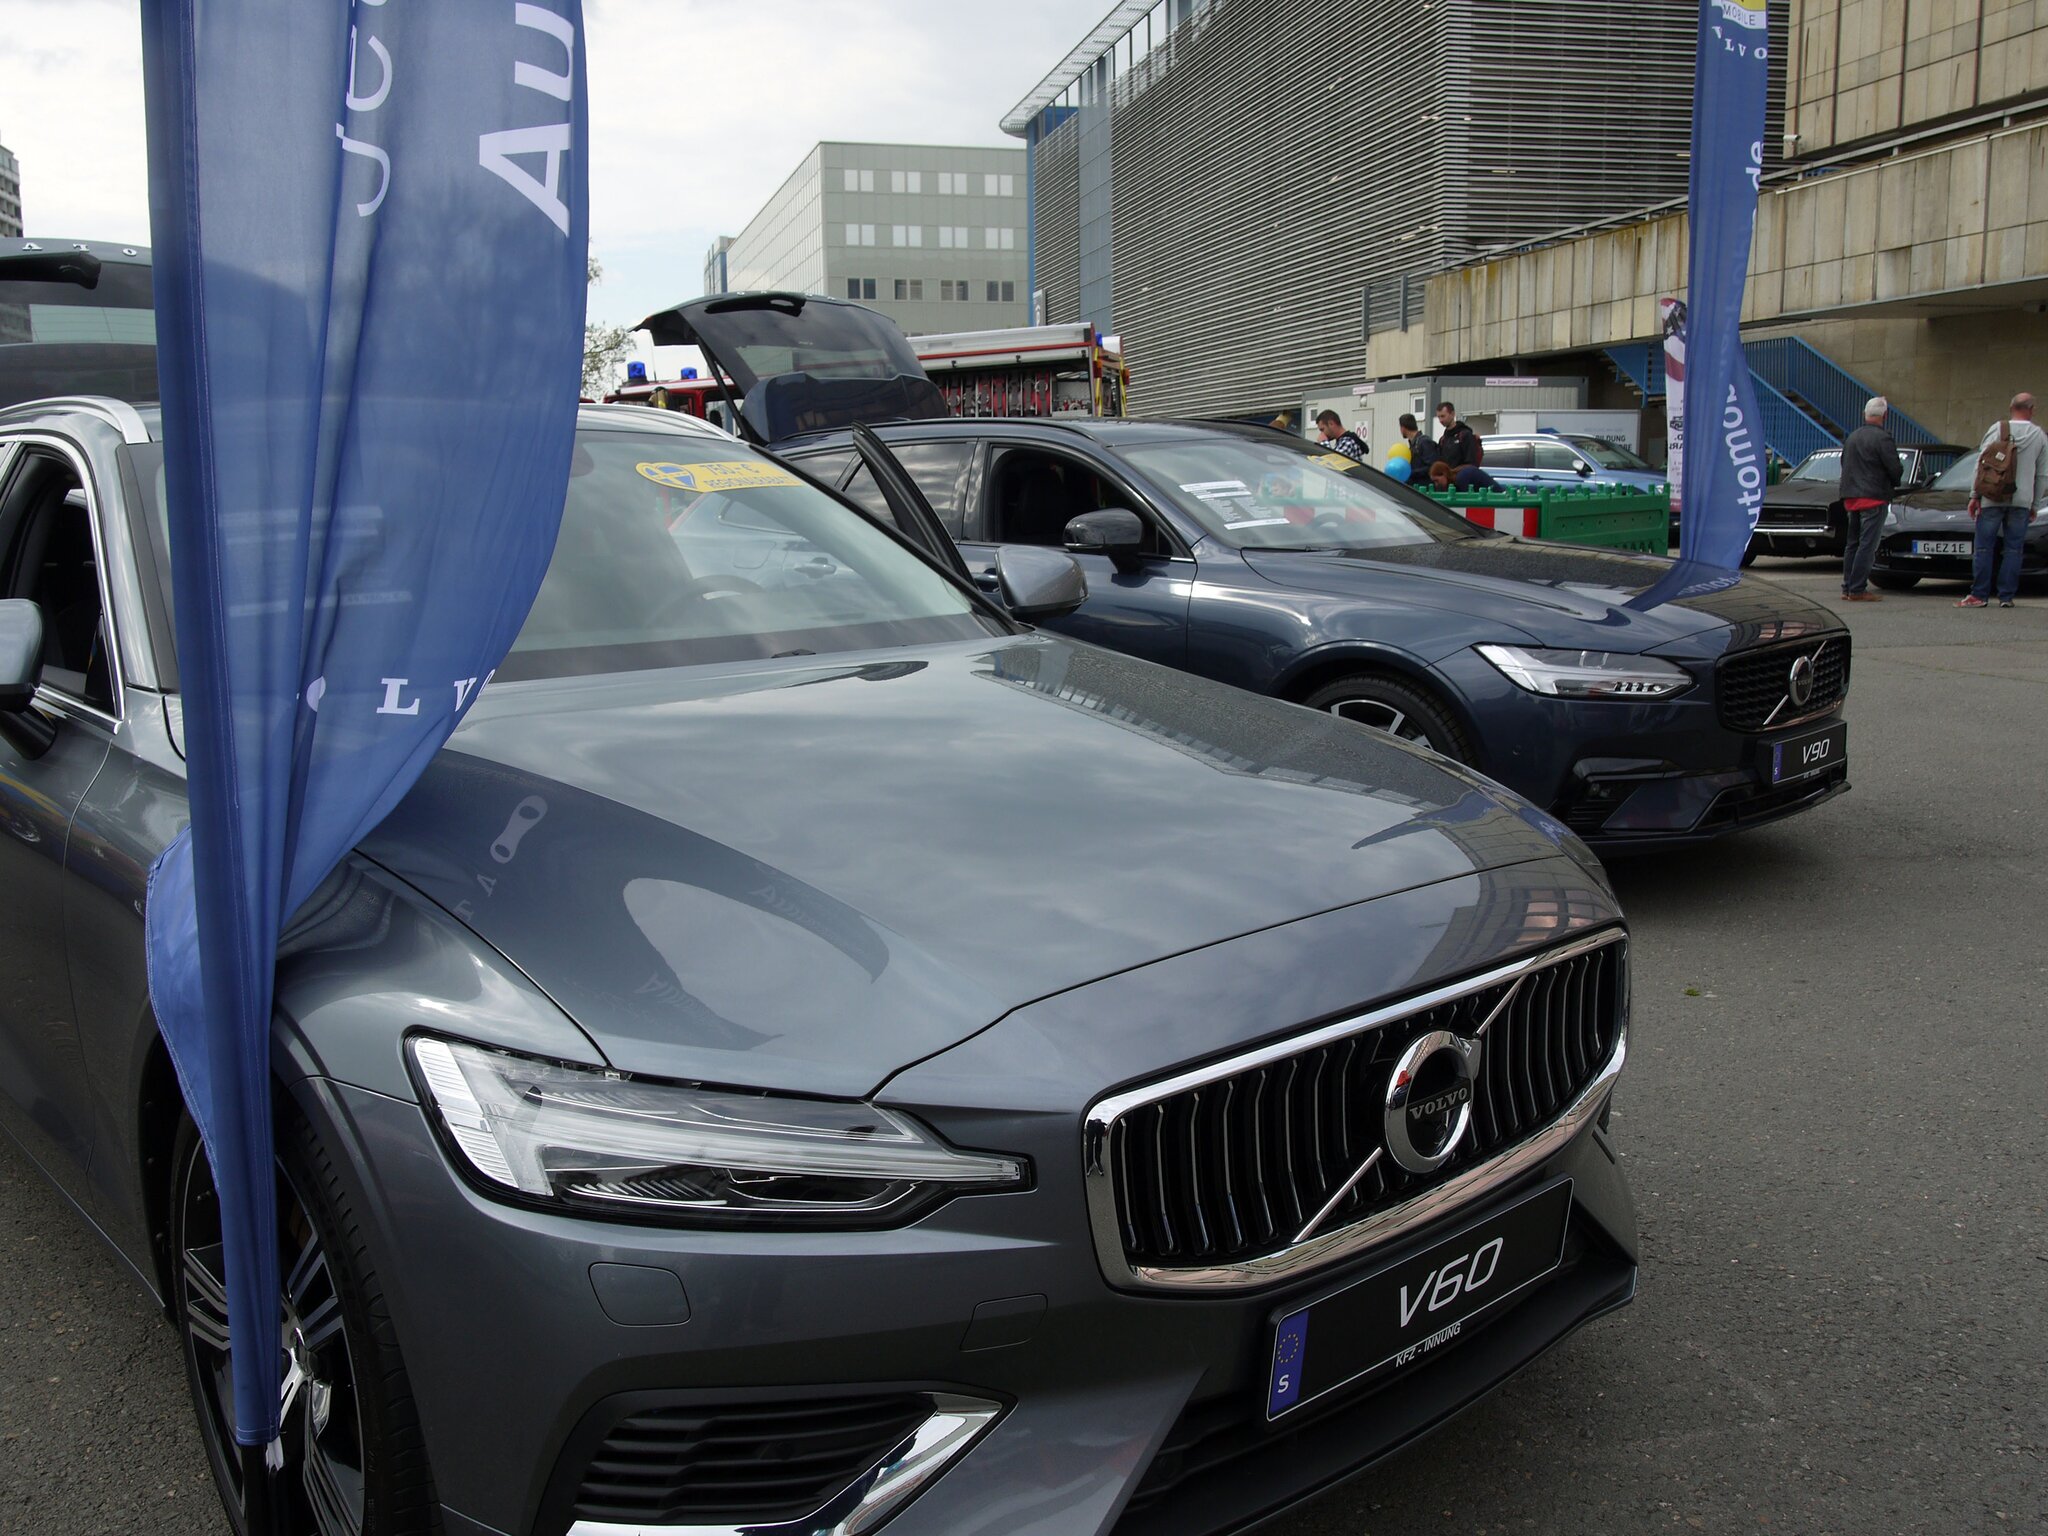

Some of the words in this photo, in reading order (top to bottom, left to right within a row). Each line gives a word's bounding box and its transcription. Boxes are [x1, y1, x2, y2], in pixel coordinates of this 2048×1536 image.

[1803, 738, 1830, 765] V90
[1409, 1087, 1468, 1120] VOLVO
[1400, 1237, 1504, 1328] V60
[1396, 1347, 1416, 1368] KFZ
[1423, 1322, 1461, 1352] INNUNG
[1277, 1374, 1290, 1394] S
